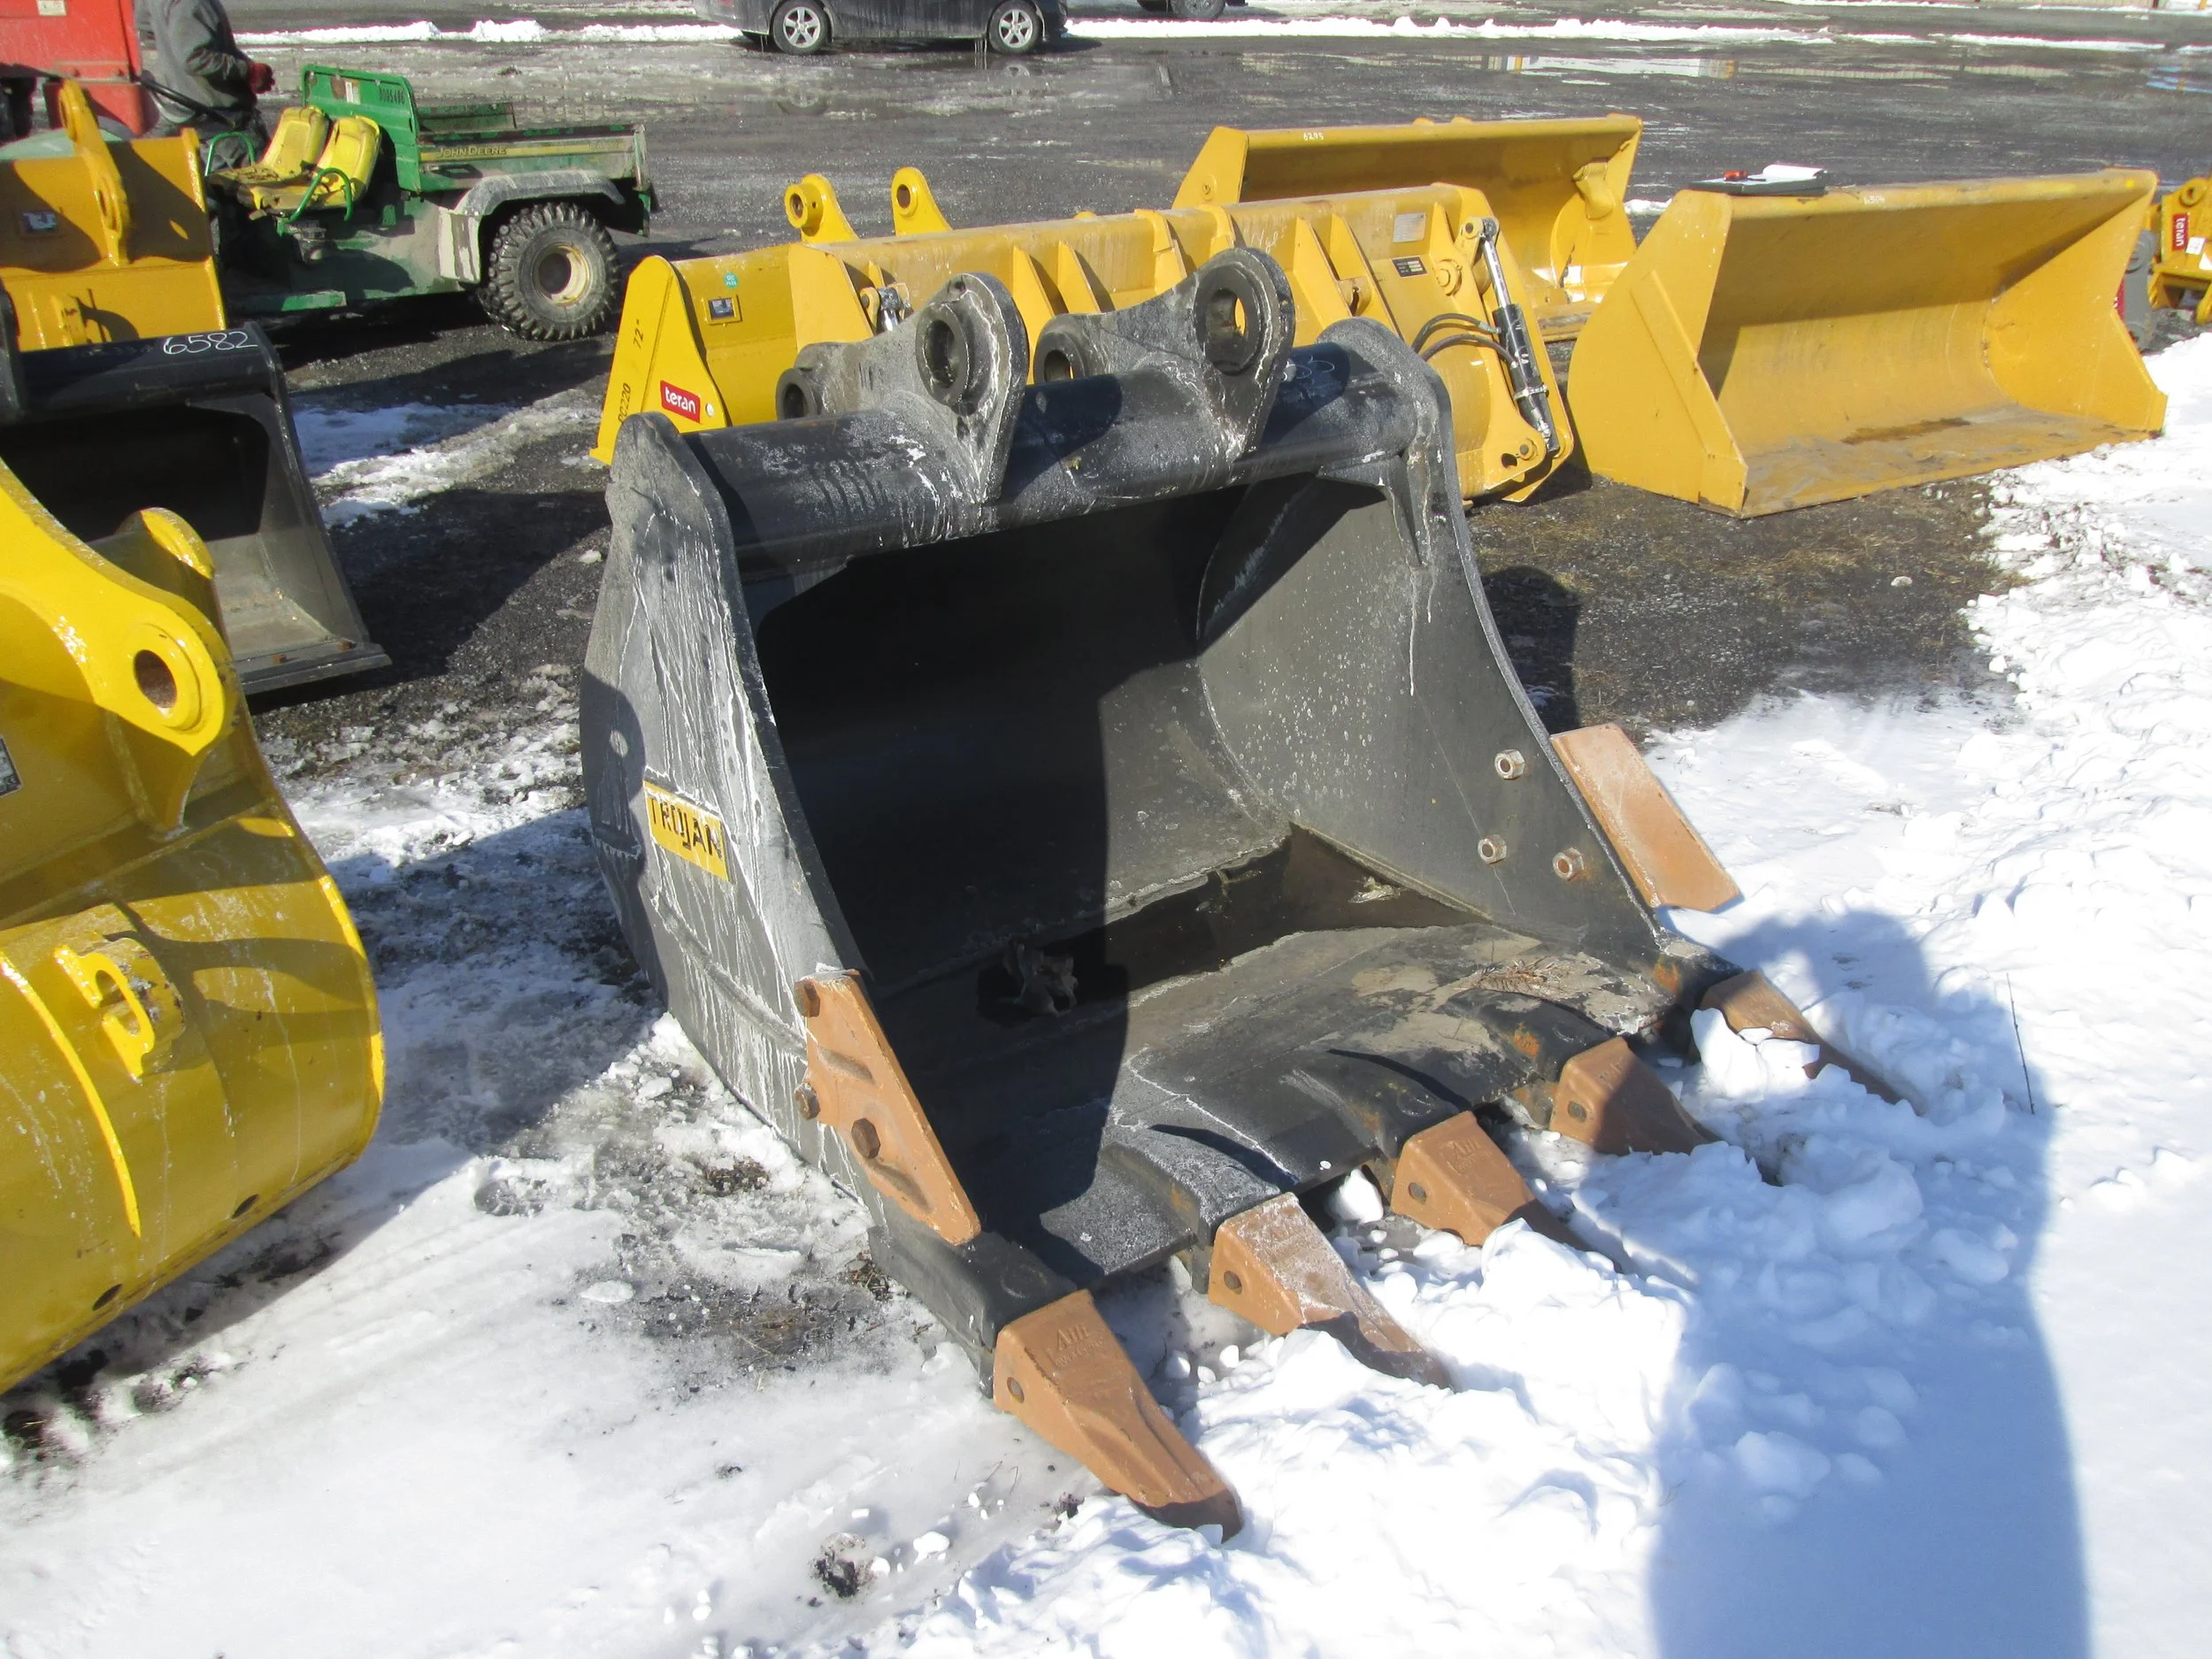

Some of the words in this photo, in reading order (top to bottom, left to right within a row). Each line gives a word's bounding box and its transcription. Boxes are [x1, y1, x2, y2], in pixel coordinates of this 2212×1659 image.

[437, 147, 467, 157] JOHN
[468, 144, 507, 157] DEERE
[2175, 217, 2186, 247] teran
[163, 331, 258, 355] 6582
[664, 386, 696, 415] teran
[650, 797, 724, 859] TROJAN
